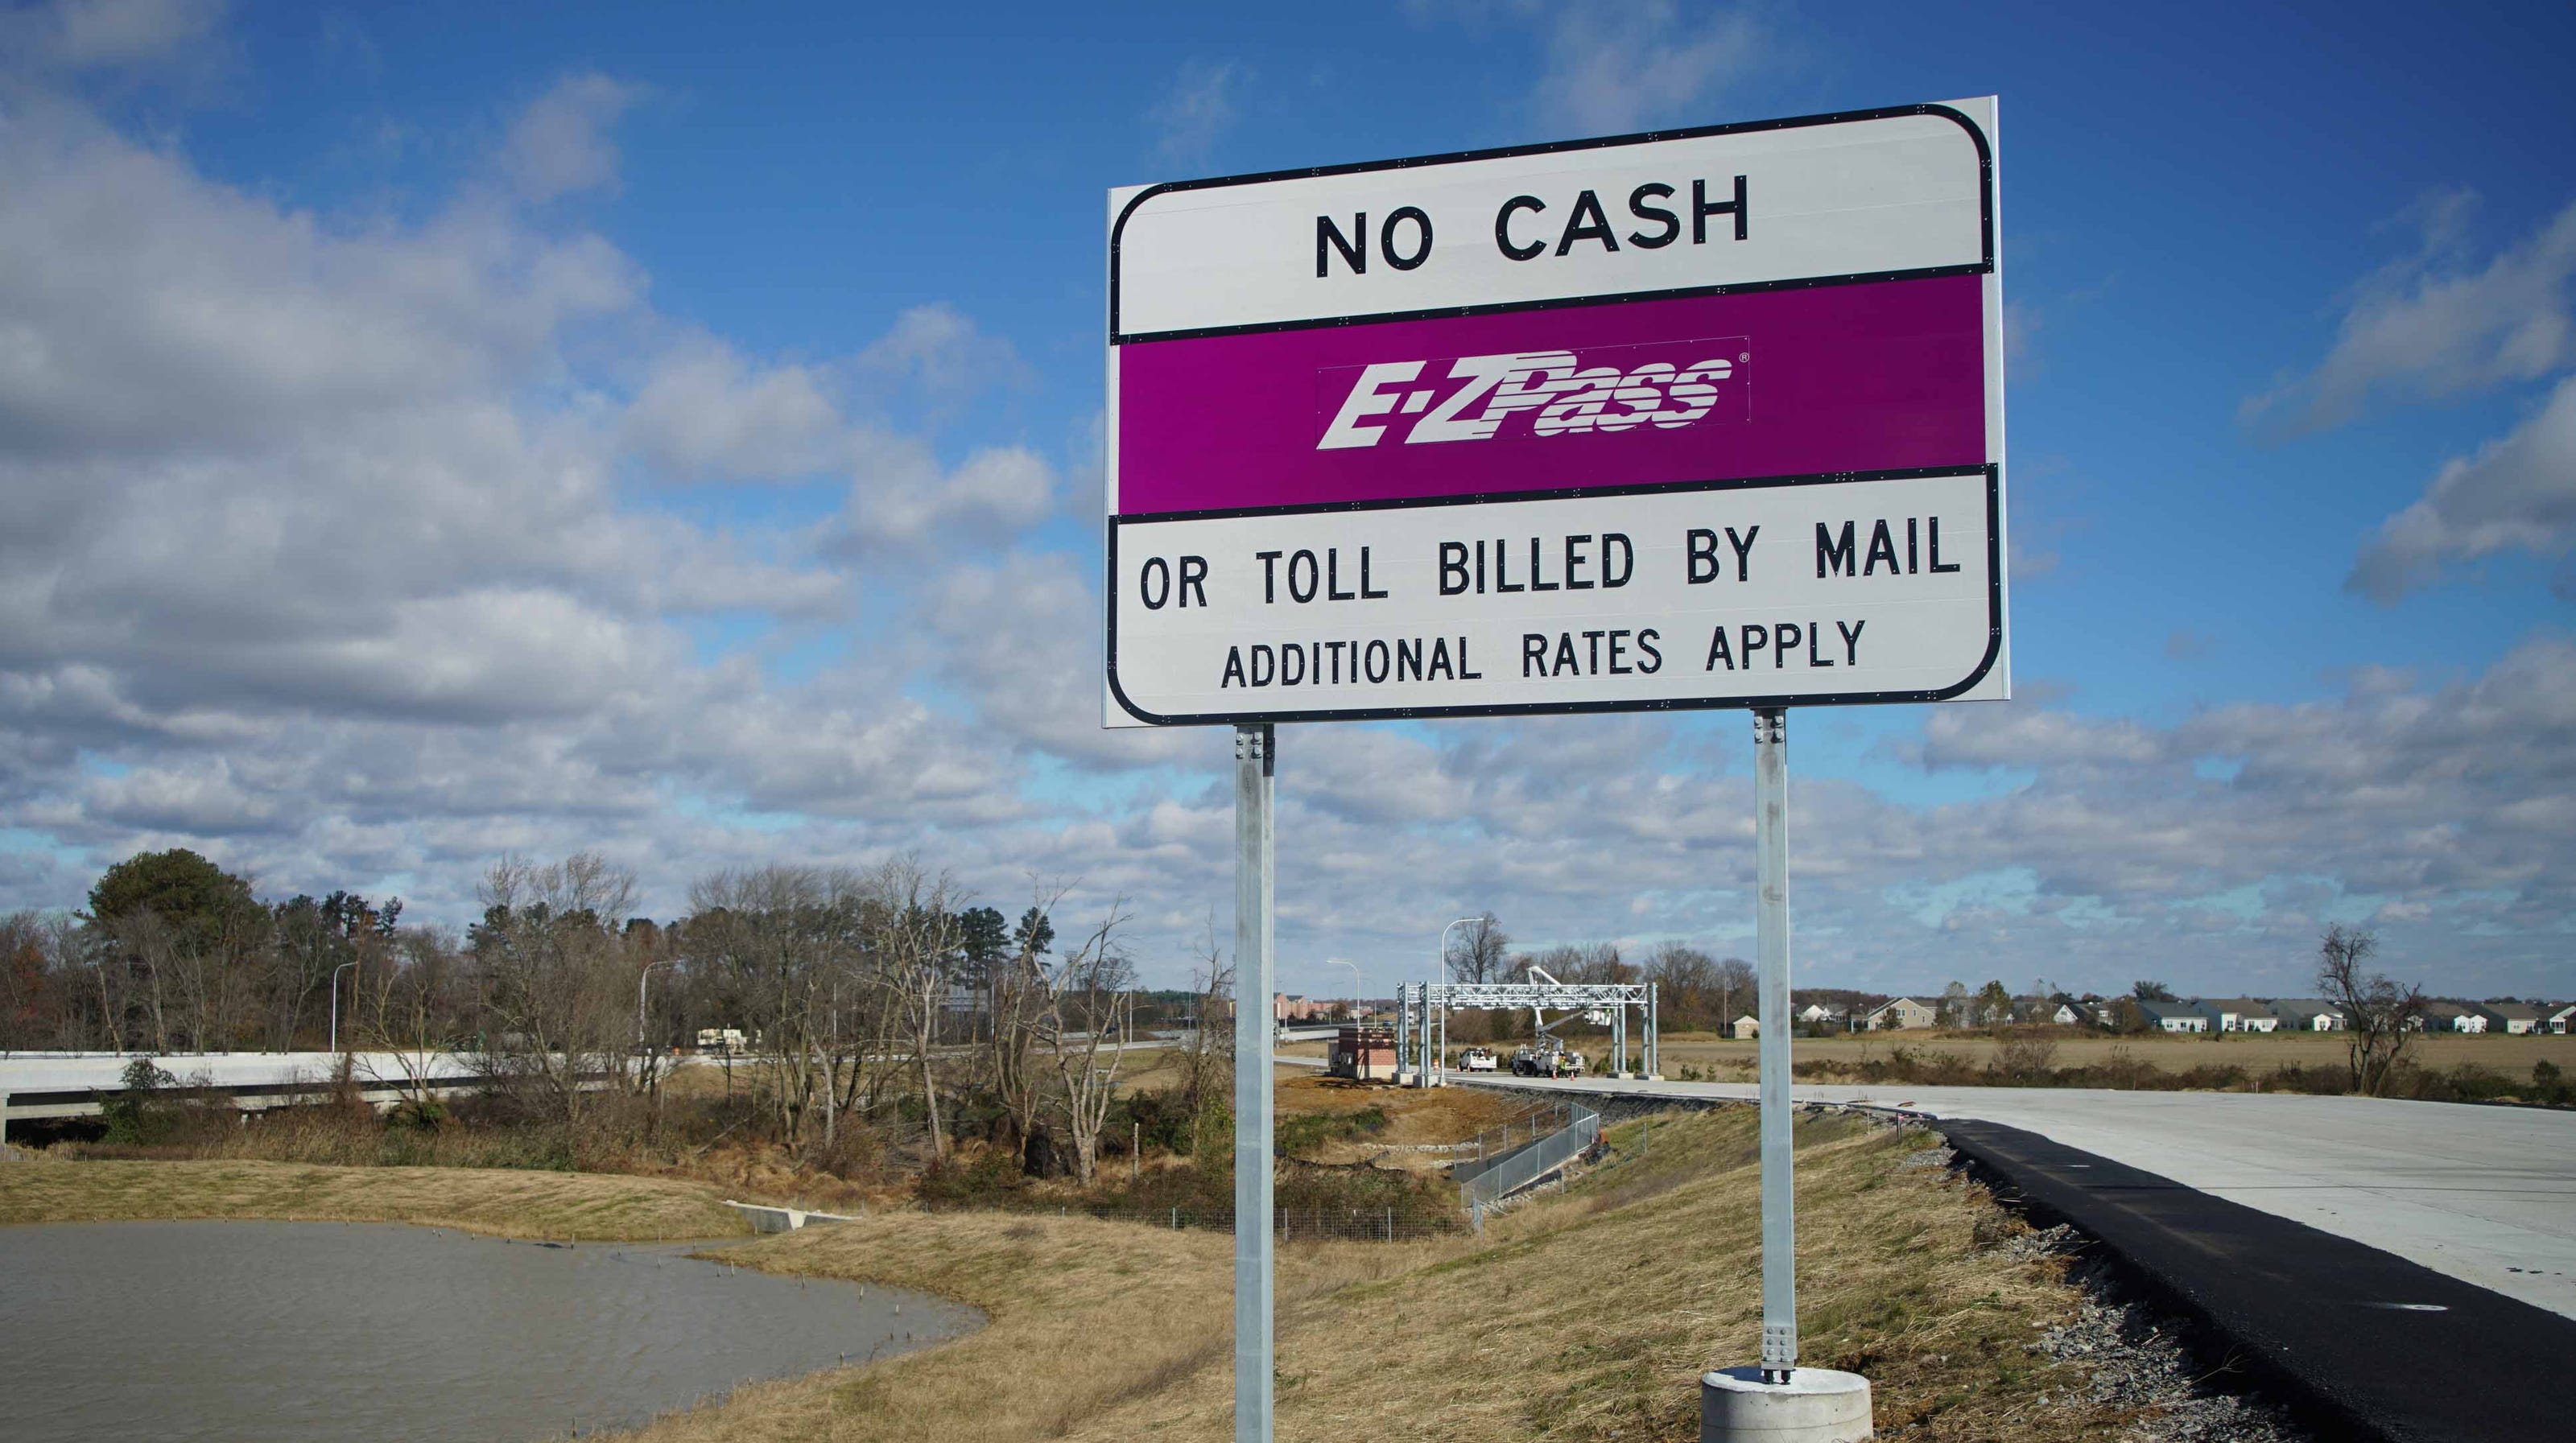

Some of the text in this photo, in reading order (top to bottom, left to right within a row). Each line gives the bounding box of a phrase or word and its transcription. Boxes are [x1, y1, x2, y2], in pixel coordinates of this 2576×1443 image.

[1316, 175, 1747, 278] NO CASH
[1140, 516, 1961, 611] OR TOLL BILLED BY MAIL
[1220, 620, 1866, 689] ADDITIONAL RATES APPLY
